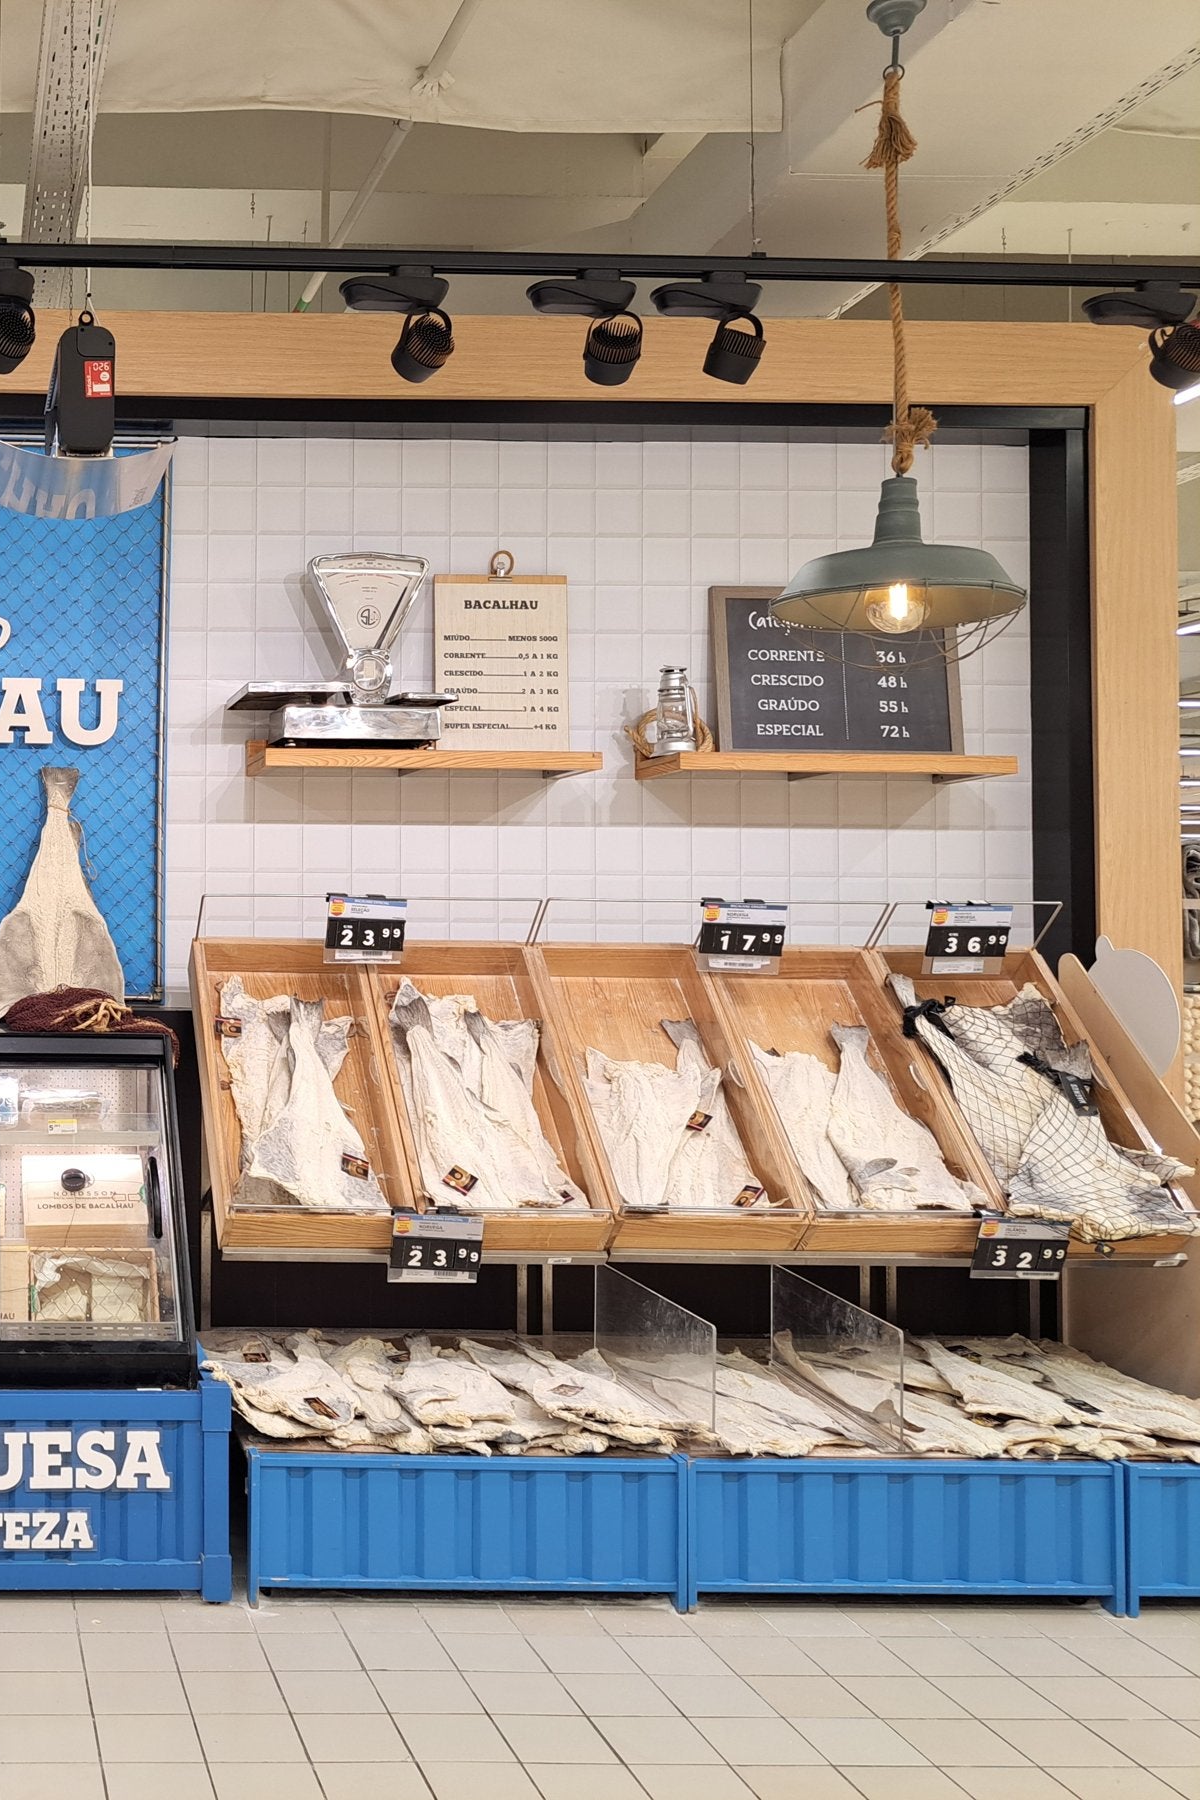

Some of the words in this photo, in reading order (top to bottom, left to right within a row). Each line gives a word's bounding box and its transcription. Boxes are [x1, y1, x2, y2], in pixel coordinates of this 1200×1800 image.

[463, 600, 538, 610] BACALHAU
[748, 649, 825, 662] CORRENTE
[876, 651, 896, 664] 36
[898, 652, 907, 664] h
[750, 674, 824, 687] CRESCIDO
[877, 676, 897, 688] 48
[899, 676, 908, 689] h
[757, 697, 820, 712] GRAÚDO
[879, 700, 898, 713] 55
[900, 701, 909, 713] h
[756, 723, 824, 737] ESPECIAL
[880, 725, 899, 738] 72
[901, 726, 910, 738] h
